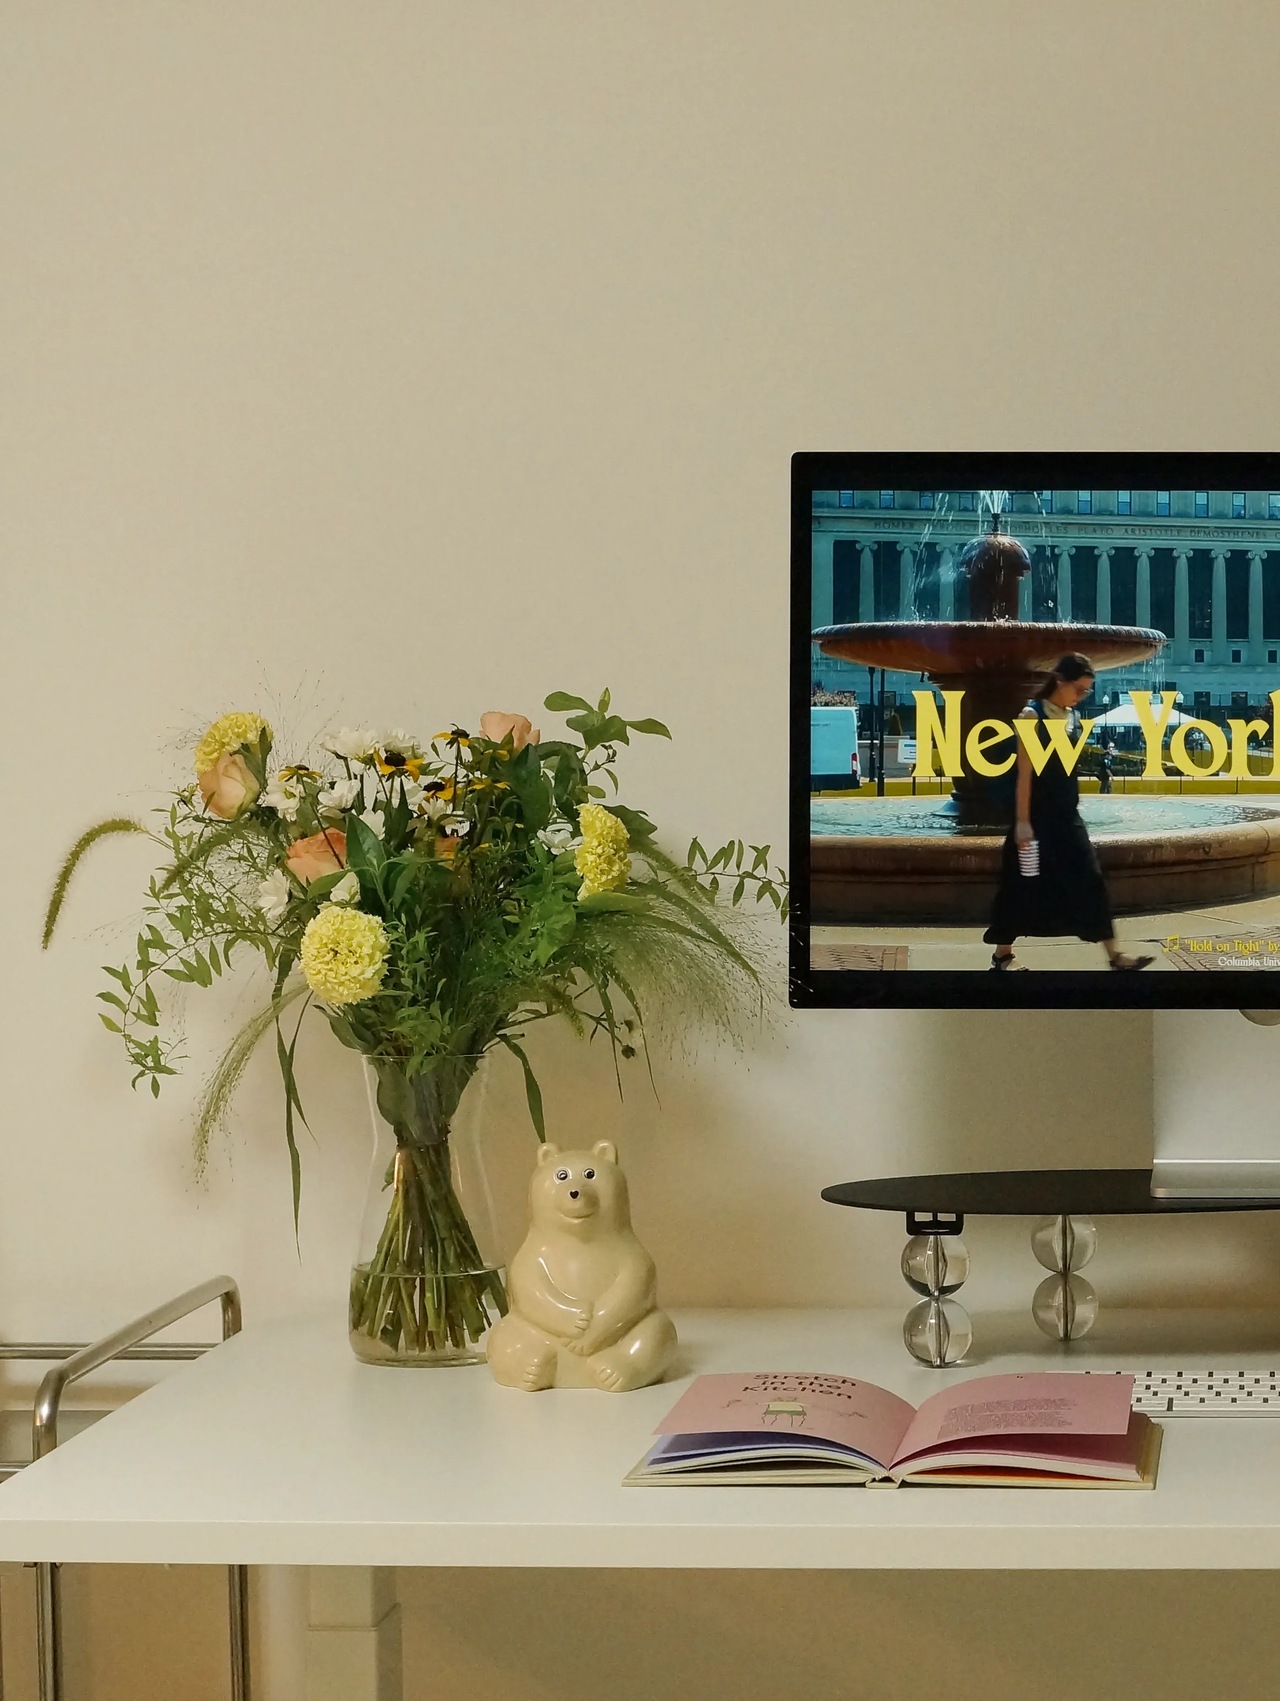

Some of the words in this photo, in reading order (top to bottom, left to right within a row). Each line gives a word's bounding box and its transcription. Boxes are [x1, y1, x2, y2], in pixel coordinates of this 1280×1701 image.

[912, 690, 1094, 777] New
[1216, 943, 1230, 952] on
[1268, 940, 1279, 954] by
[1218, 956, 1261, 967] Columbia
[753, 1374, 856, 1387] Stretch
[798, 1381, 842, 1390] the
[742, 1386, 852, 1400] Kitchen
